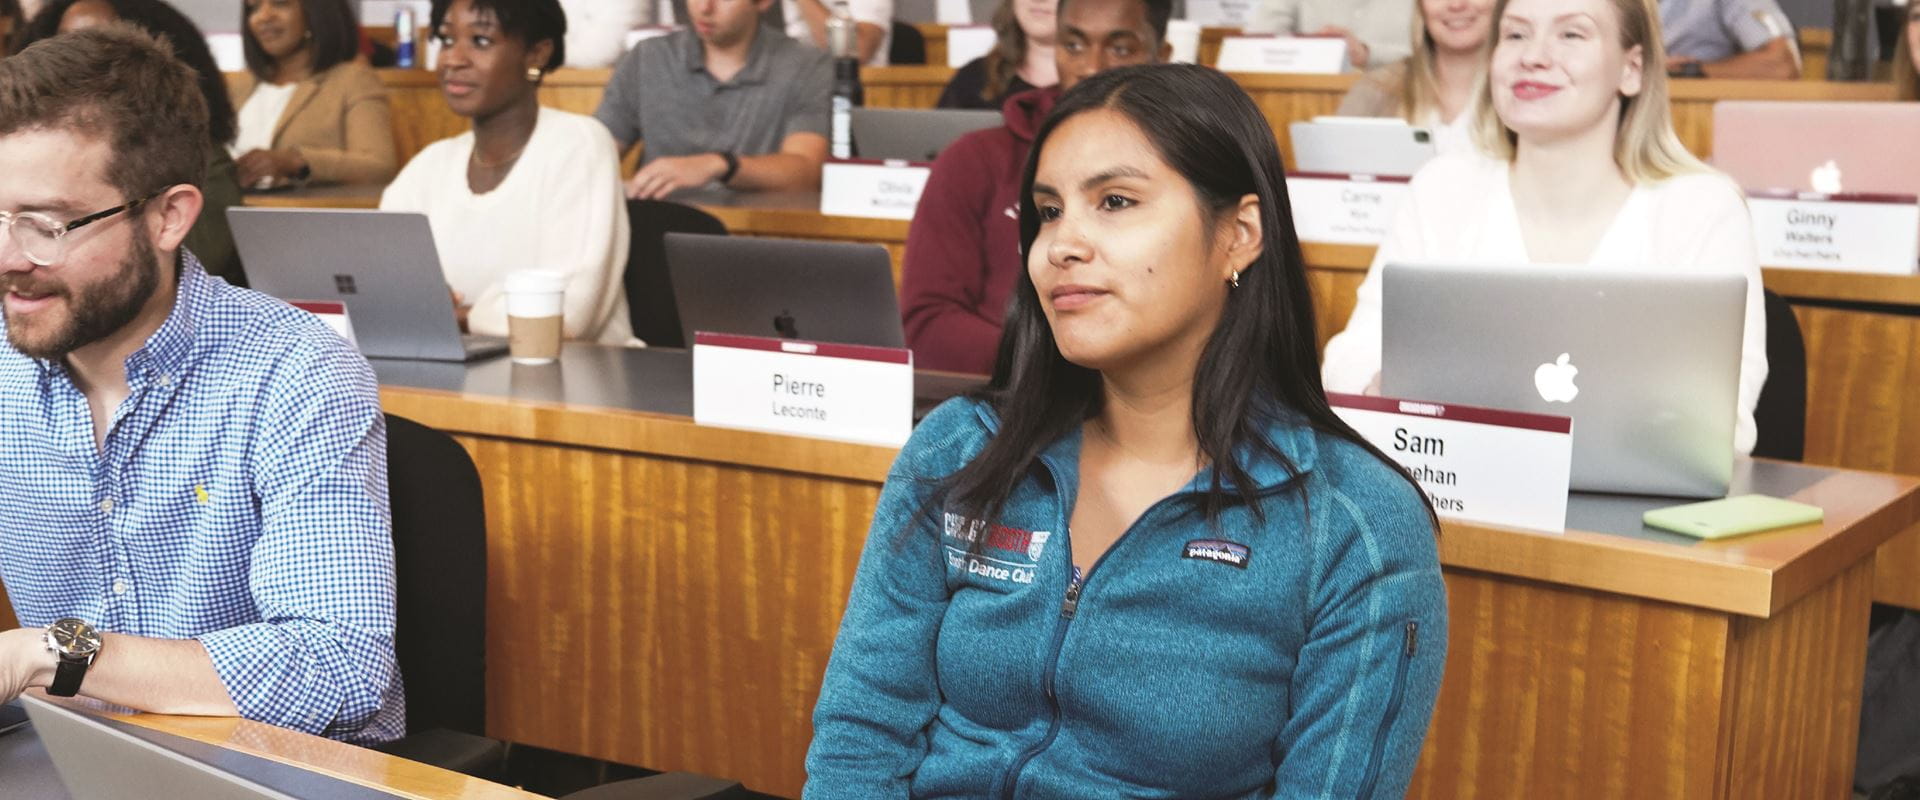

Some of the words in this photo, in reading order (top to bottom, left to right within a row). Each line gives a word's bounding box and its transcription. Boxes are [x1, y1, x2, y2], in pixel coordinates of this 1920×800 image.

[1787, 208, 1837, 230] Ginny
[773, 374, 825, 398] Pierre
[772, 401, 826, 421] Leconte
[1394, 427, 1444, 456] Sam
[1189, 548, 1241, 564] patagonia
[968, 559, 1010, 580] Dance
